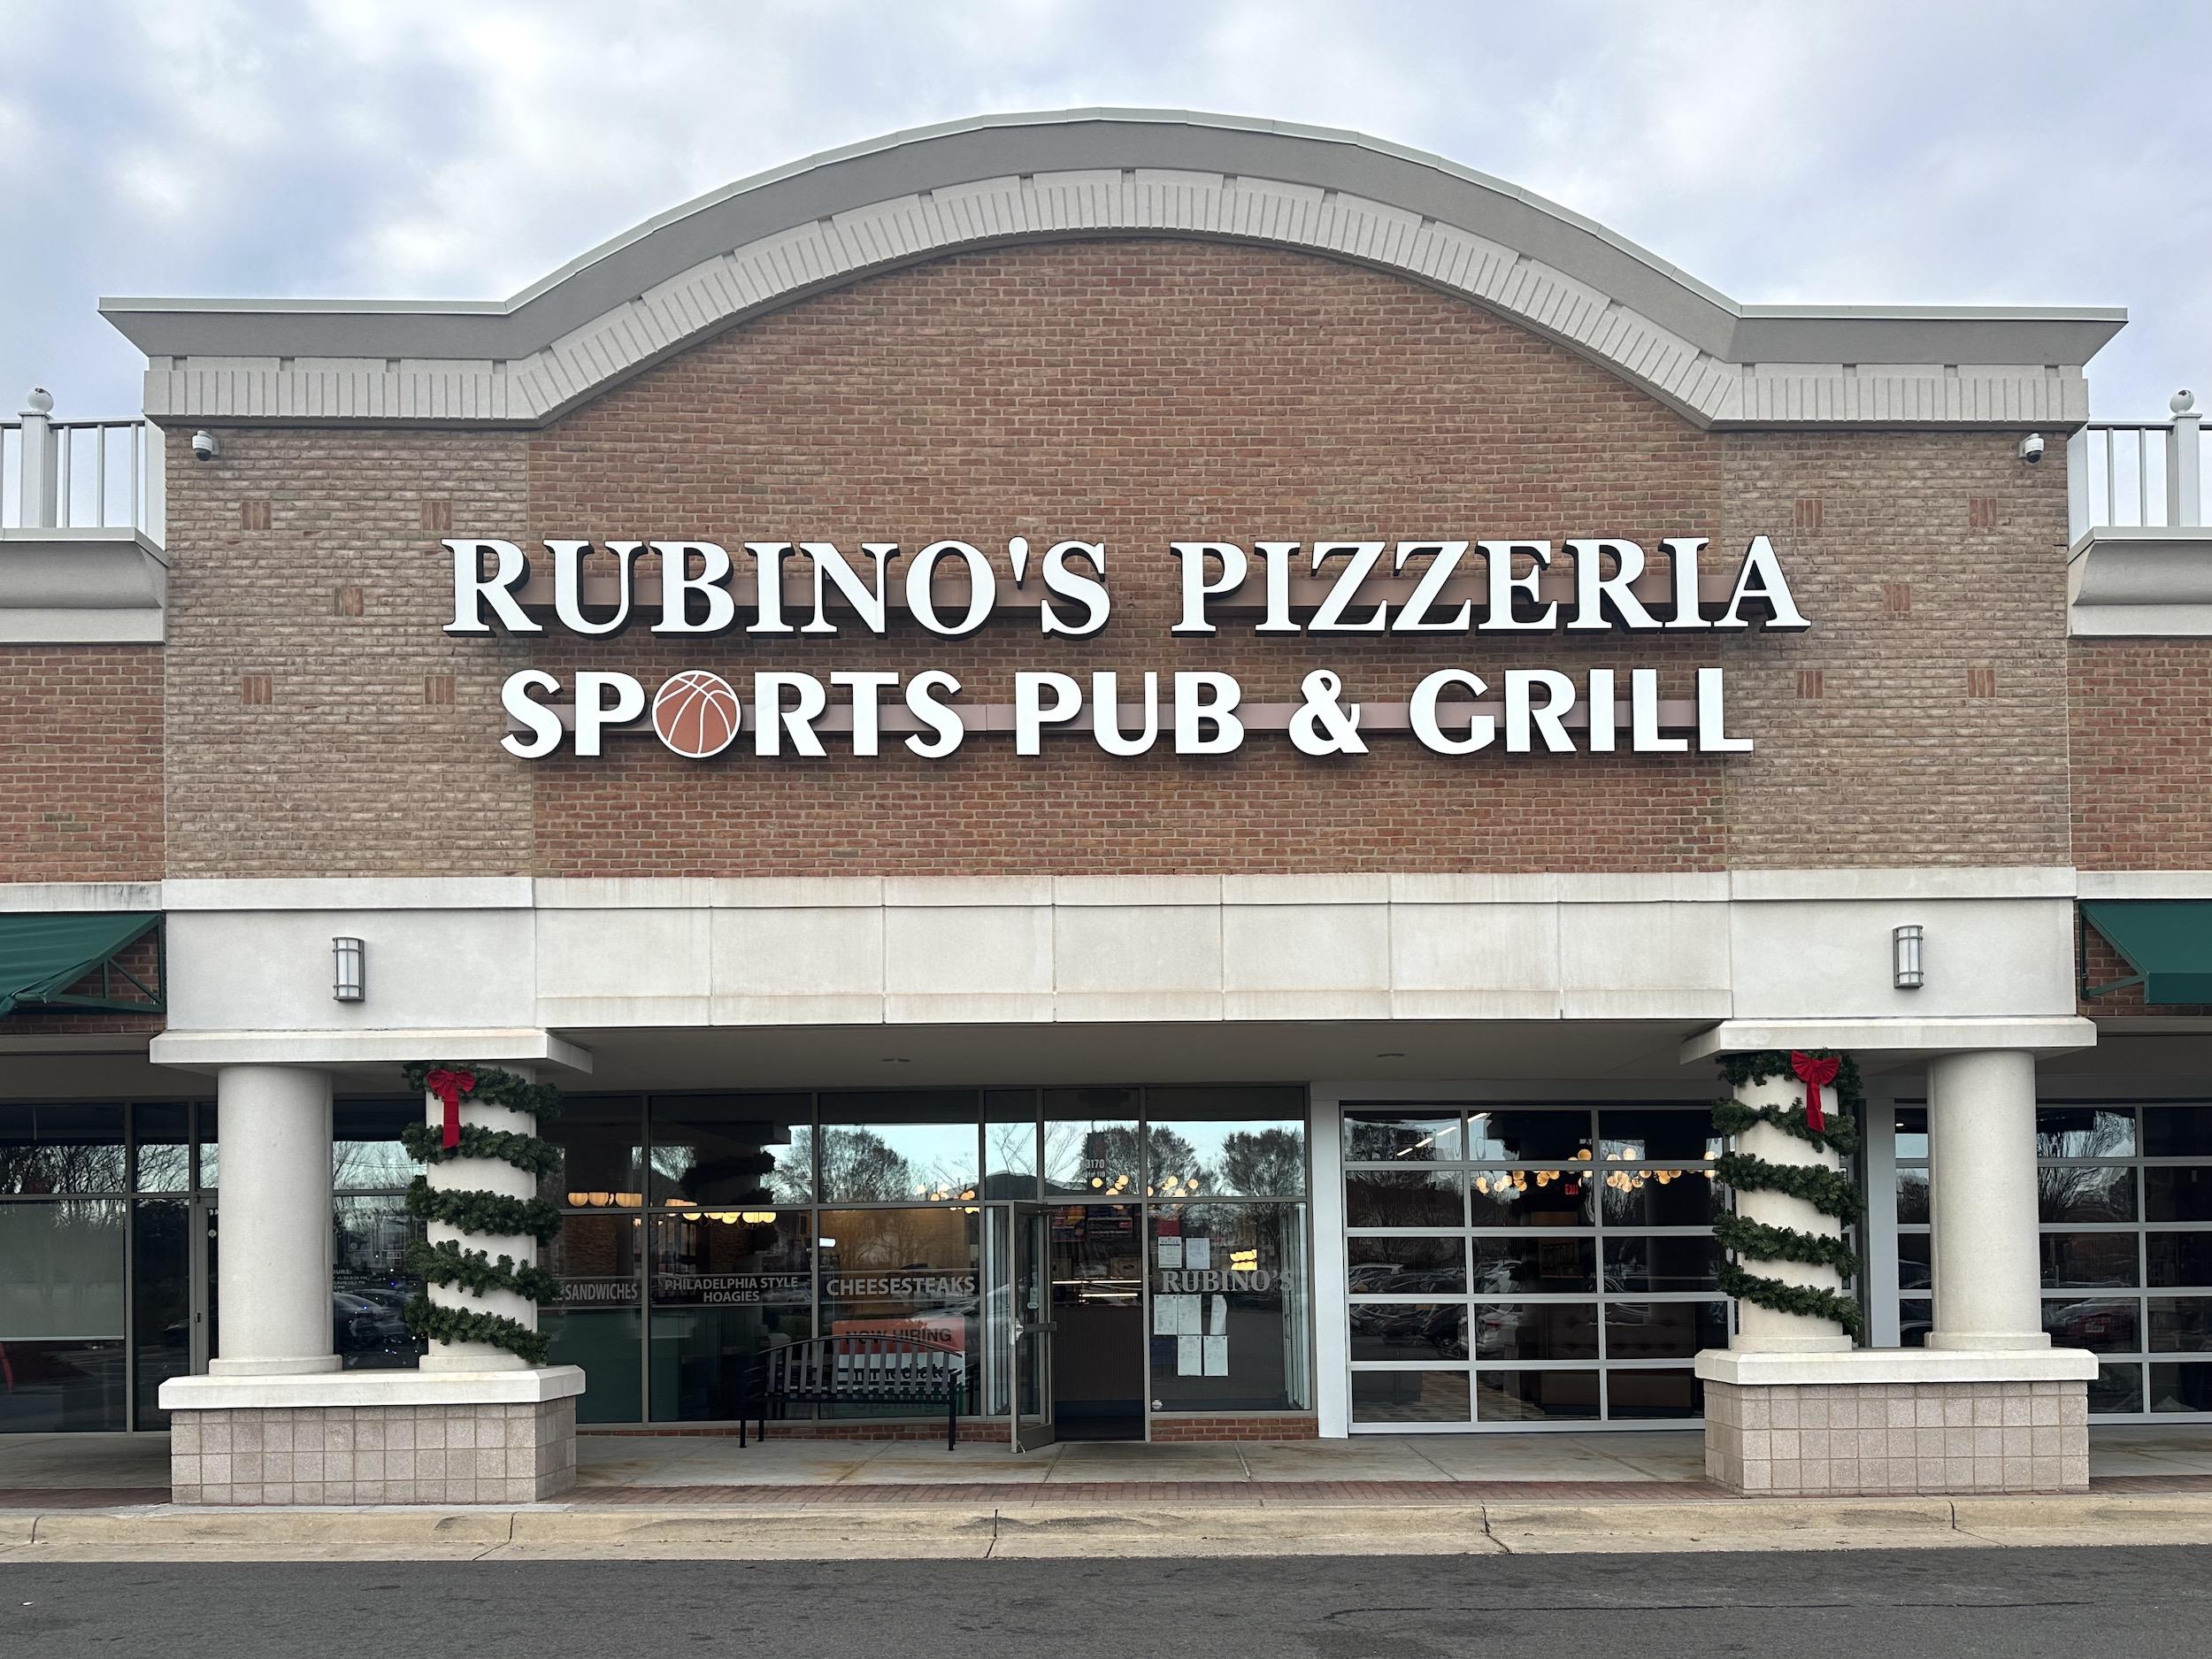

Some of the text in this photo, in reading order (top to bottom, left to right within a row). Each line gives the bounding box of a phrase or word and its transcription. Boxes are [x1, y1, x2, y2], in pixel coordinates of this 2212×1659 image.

[442, 535, 1812, 637] RUBINO'S PIZZERIA
[499, 667, 1755, 758] SPORTS PUB & GRILL
[1086, 1158, 1105, 1169] 3170
[1564, 1183, 1579, 1195] EXIT
[664, 1276, 799, 1291] PHILADELPHIA STYLE
[826, 1276, 976, 1297] CHEESESTEAKS
[565, 1283, 638, 1302] SANDWICHES
[703, 1291, 760, 1303] HOAGIES
[892, 1327, 952, 1343] HIRING
